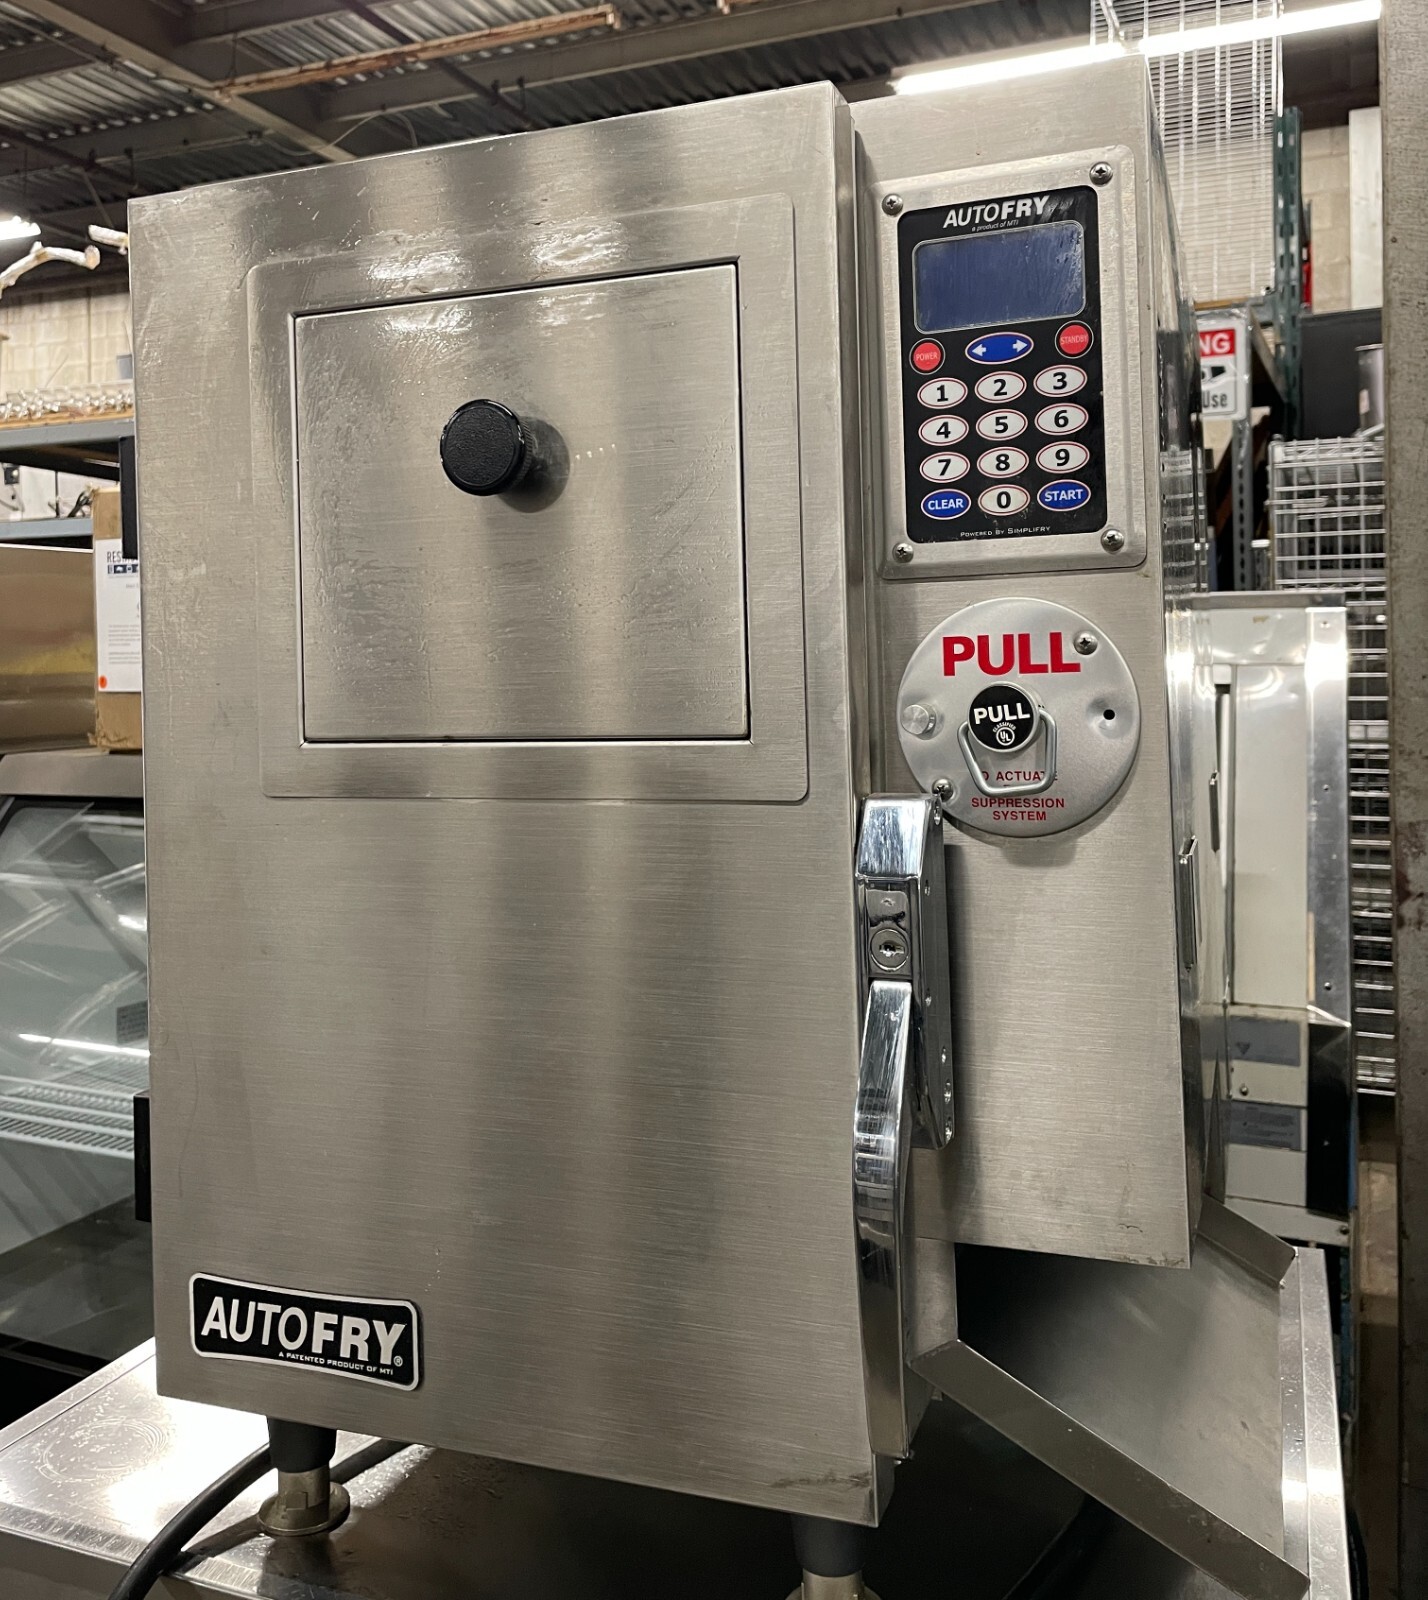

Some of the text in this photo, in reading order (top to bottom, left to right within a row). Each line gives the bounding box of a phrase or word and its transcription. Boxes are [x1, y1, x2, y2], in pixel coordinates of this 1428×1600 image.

[943, 195, 1050, 228] AUTOFRY
[976, 222, 1000, 232] product
[1059, 333, 1089, 345] STANDBY
[915, 351, 938, 361] POWER
[993, 378, 1008, 397] 2
[1052, 371, 1068, 390] 3
[936, 384, 949, 402] 1
[994, 415, 1009, 434] 5
[1054, 409, 1069, 428] 6
[936, 421, 951, 439] 4
[995, 453, 1010, 472] 8
[1055, 448, 1070, 467] 9
[937, 458, 952, 476] 7
[927, 498, 964, 510] CLEAR
[996, 490, 1012, 509] 0
[1044, 488, 1084, 502] START
[942, 631, 1081, 677] PULL
[973, 702, 1031, 725] PULL
[1000, 730, 1011, 742] UL
[996, 770, 1058, 781] ACTUA
[971, 797, 1065, 808] SUPPRESSION
[992, 810, 1047, 821] SYSTEM
[286, 1352, 325, 1365] PATENTED
[326, 1359, 365, 1371] PRODUCT
[366, 1365, 378, 1373] OF
